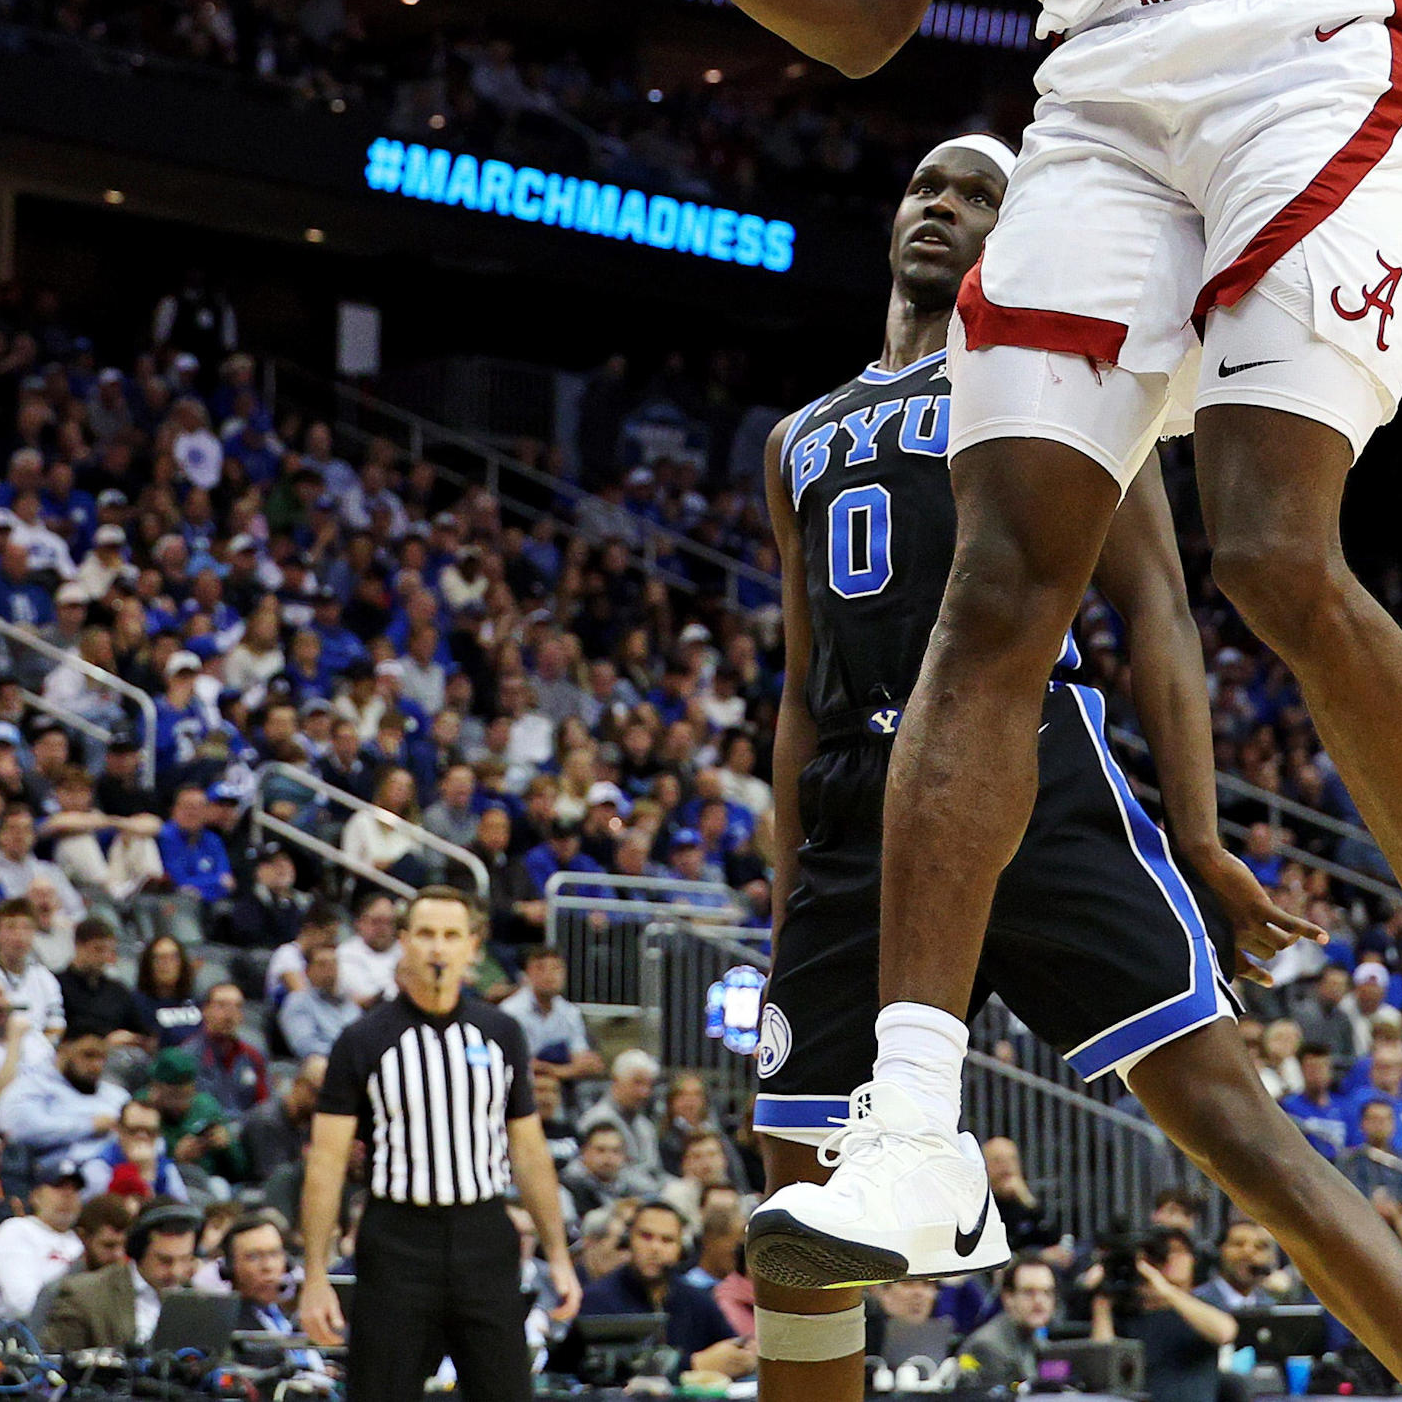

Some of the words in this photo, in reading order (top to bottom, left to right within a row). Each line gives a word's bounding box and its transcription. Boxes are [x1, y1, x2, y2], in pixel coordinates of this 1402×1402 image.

[364, 136, 796, 273] #MARCHMADNESS
[790, 395, 950, 512] BYU
[828, 483, 894, 599] 0
[871, 709, 898, 734] Y
